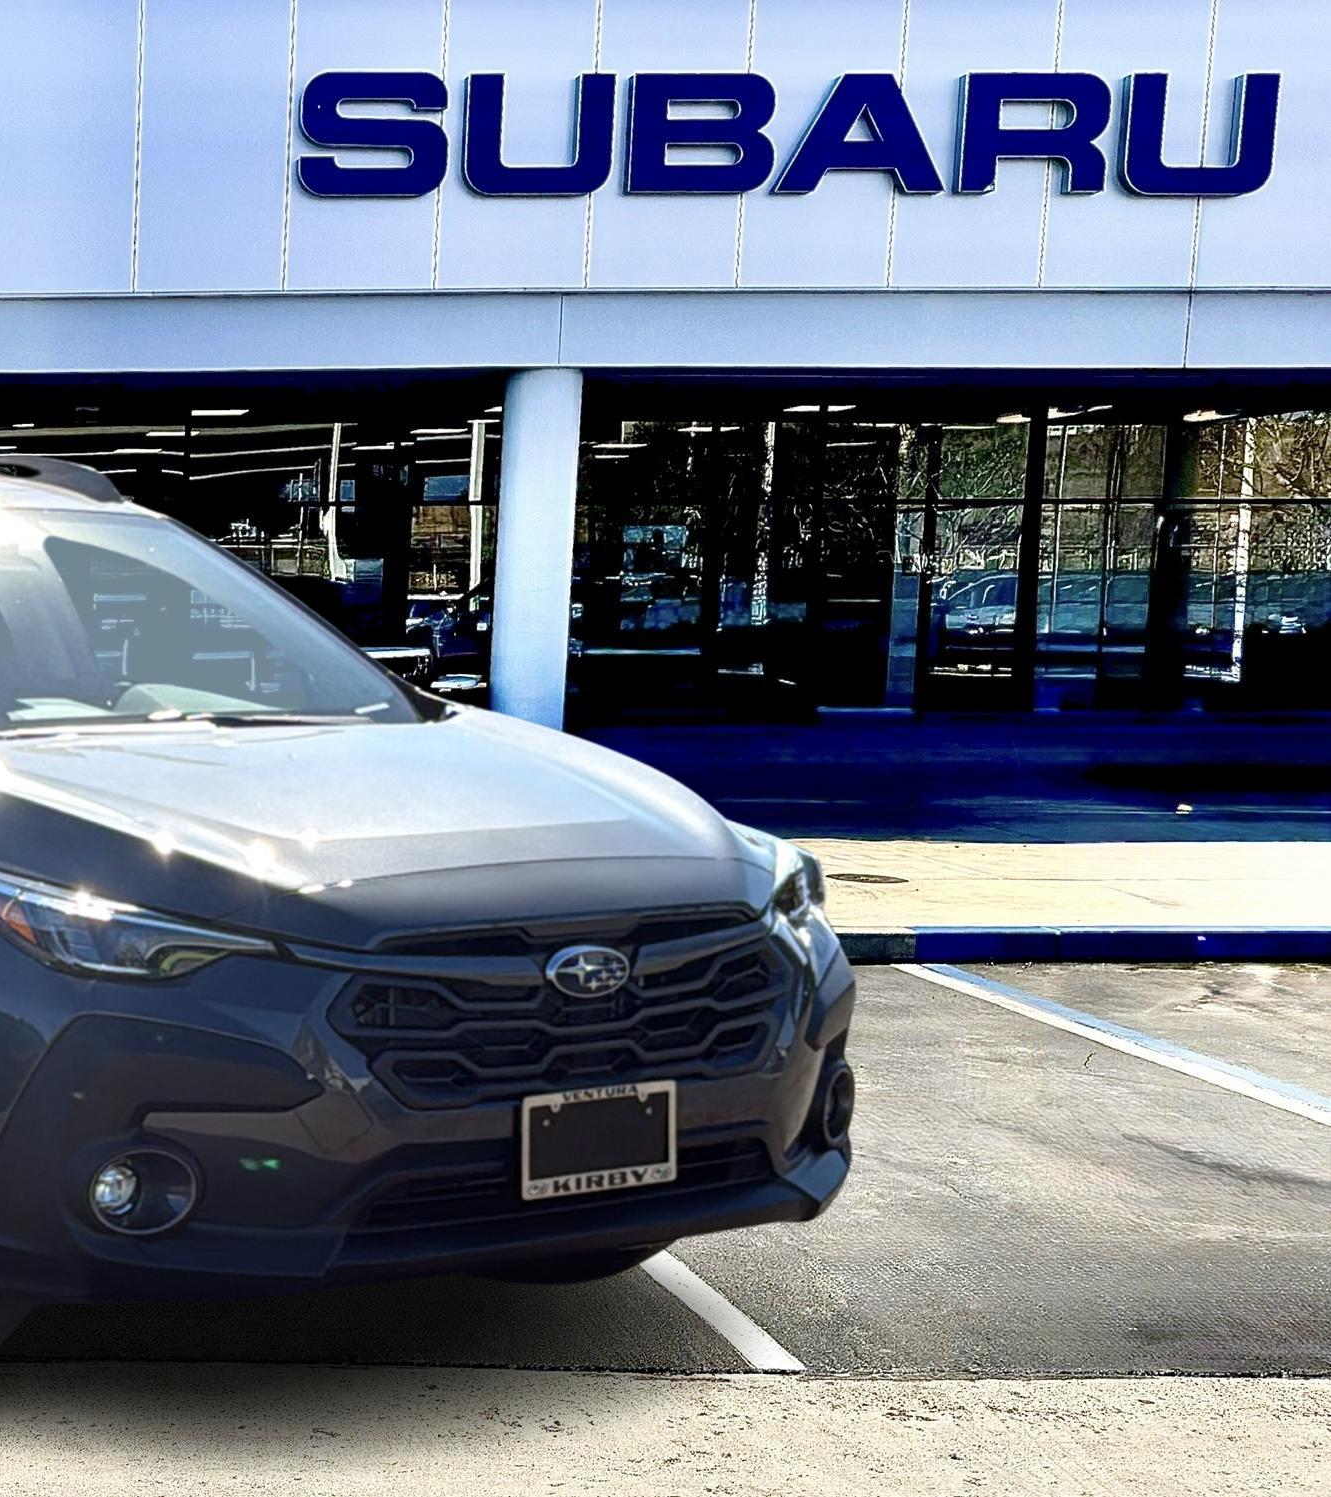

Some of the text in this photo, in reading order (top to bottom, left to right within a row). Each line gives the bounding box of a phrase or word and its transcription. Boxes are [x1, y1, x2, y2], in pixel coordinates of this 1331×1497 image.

[297, 71, 1282, 198] SUBARU
[561, 1085, 638, 1102] VENTURA
[553, 1169, 648, 1193] KIRBY
